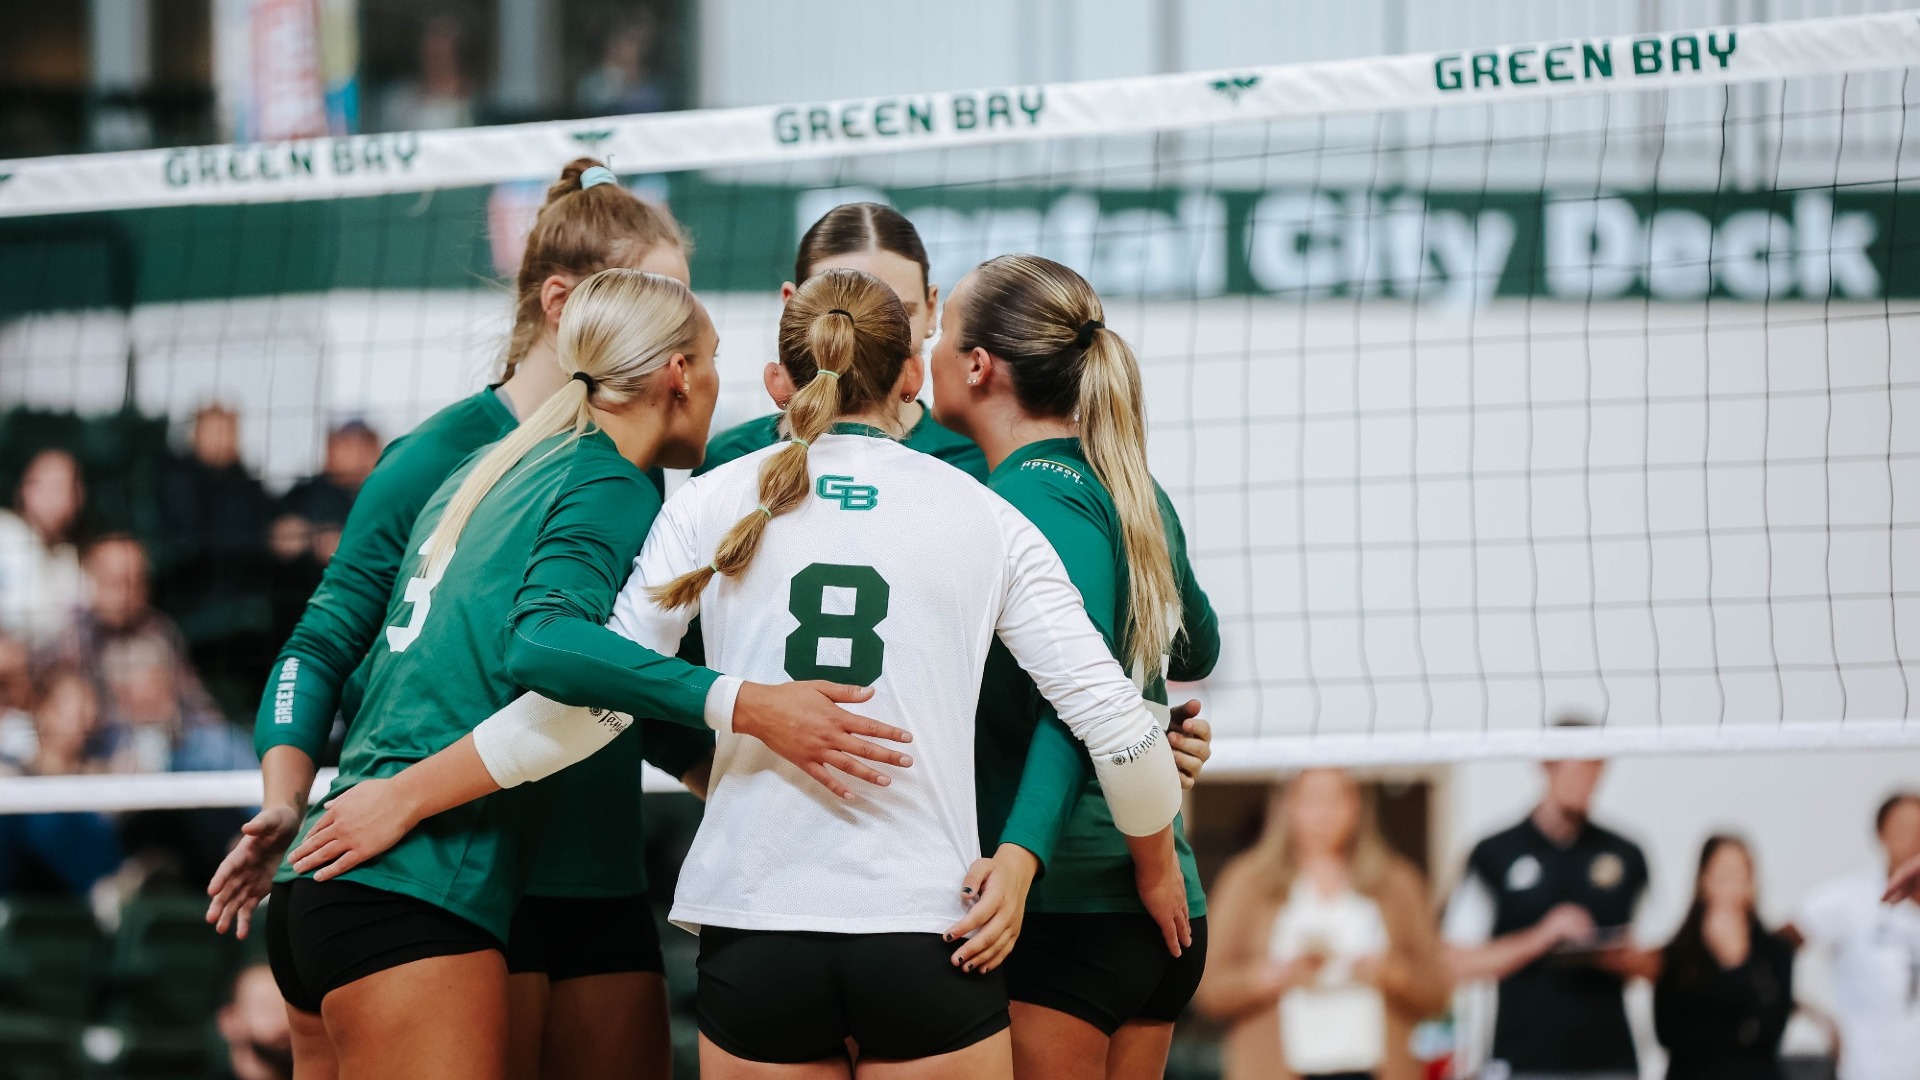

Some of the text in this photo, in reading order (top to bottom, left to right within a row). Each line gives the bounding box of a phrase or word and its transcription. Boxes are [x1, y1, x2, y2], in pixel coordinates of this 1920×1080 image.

[1435, 32, 1737, 91] GREEN BAY
[774, 90, 1044, 145] GREEN BAY
[164, 134, 419, 186] GREEN BAY
[1244, 188, 1516, 312] City
[1543, 188, 1882, 298] Deck
[816, 474, 879, 511] GB
[1021, 461, 1081, 480] HORIZON
[385, 530, 457, 653] 3
[784, 562, 890, 687] 8
[274, 682, 296, 724] GREEN
